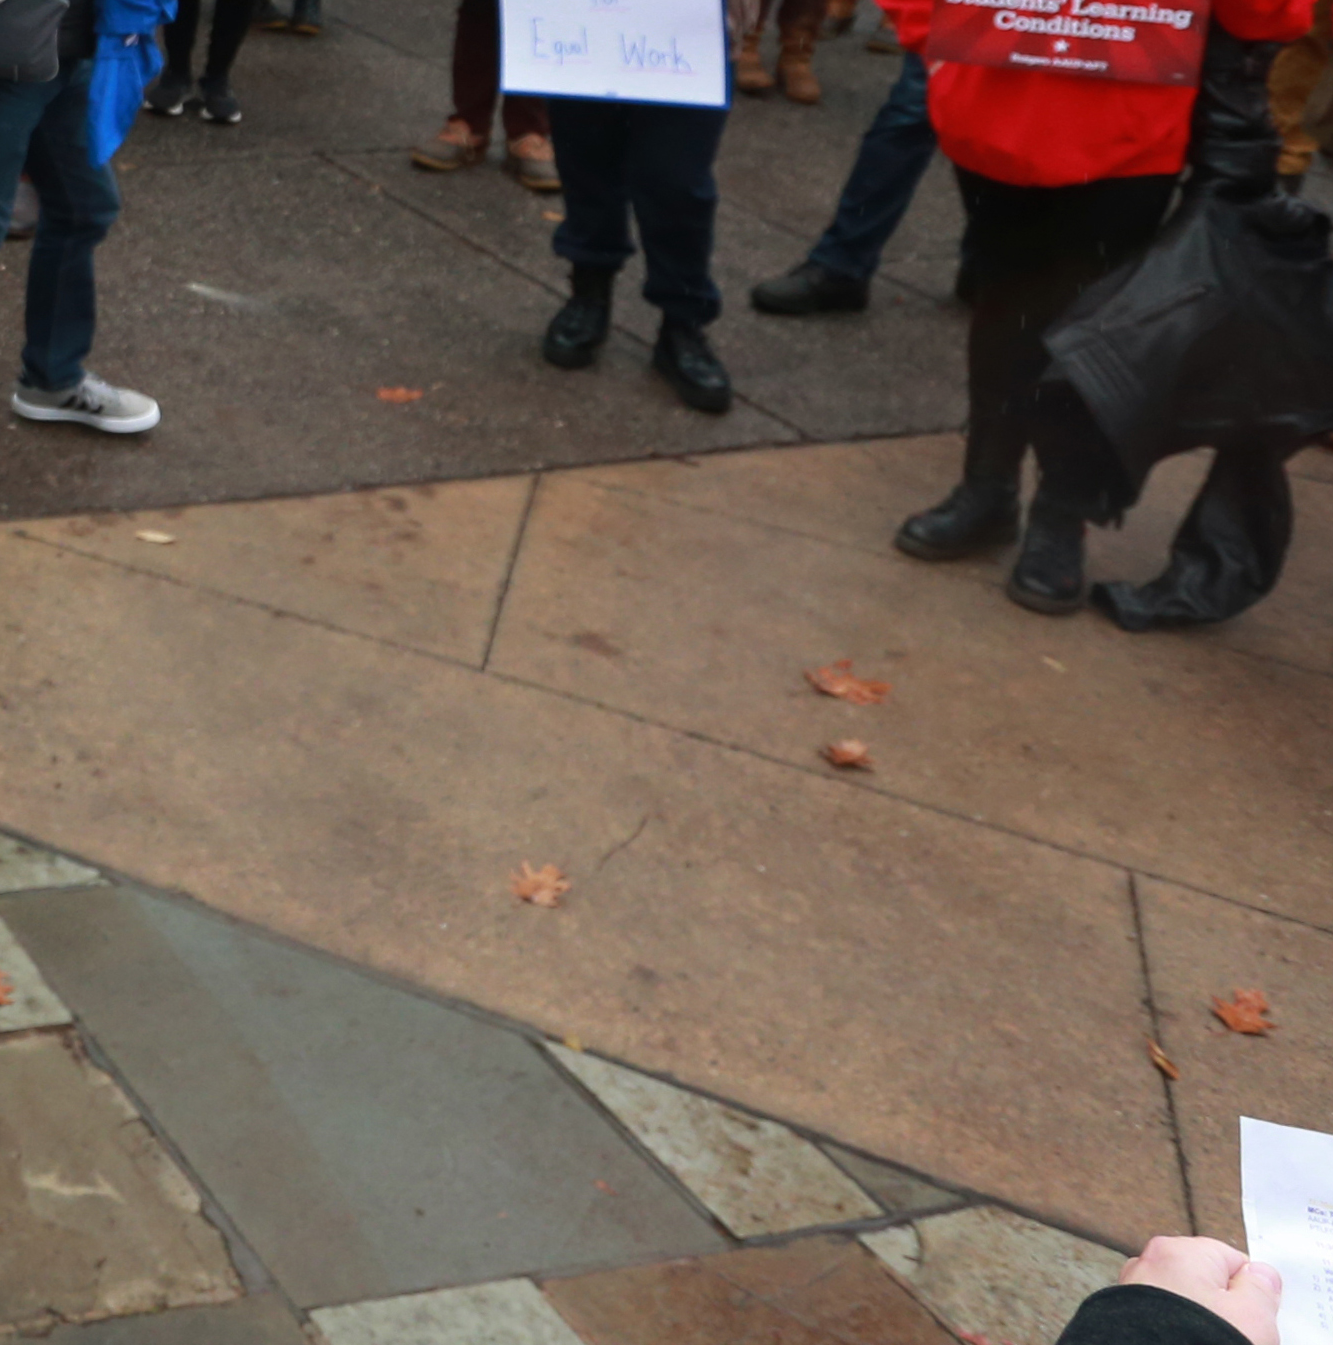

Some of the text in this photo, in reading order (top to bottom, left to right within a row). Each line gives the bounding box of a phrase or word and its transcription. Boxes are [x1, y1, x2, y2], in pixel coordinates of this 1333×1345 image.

[532, 16, 693, 74] Equal Work
[994, 9, 1136, 43] Conditions
